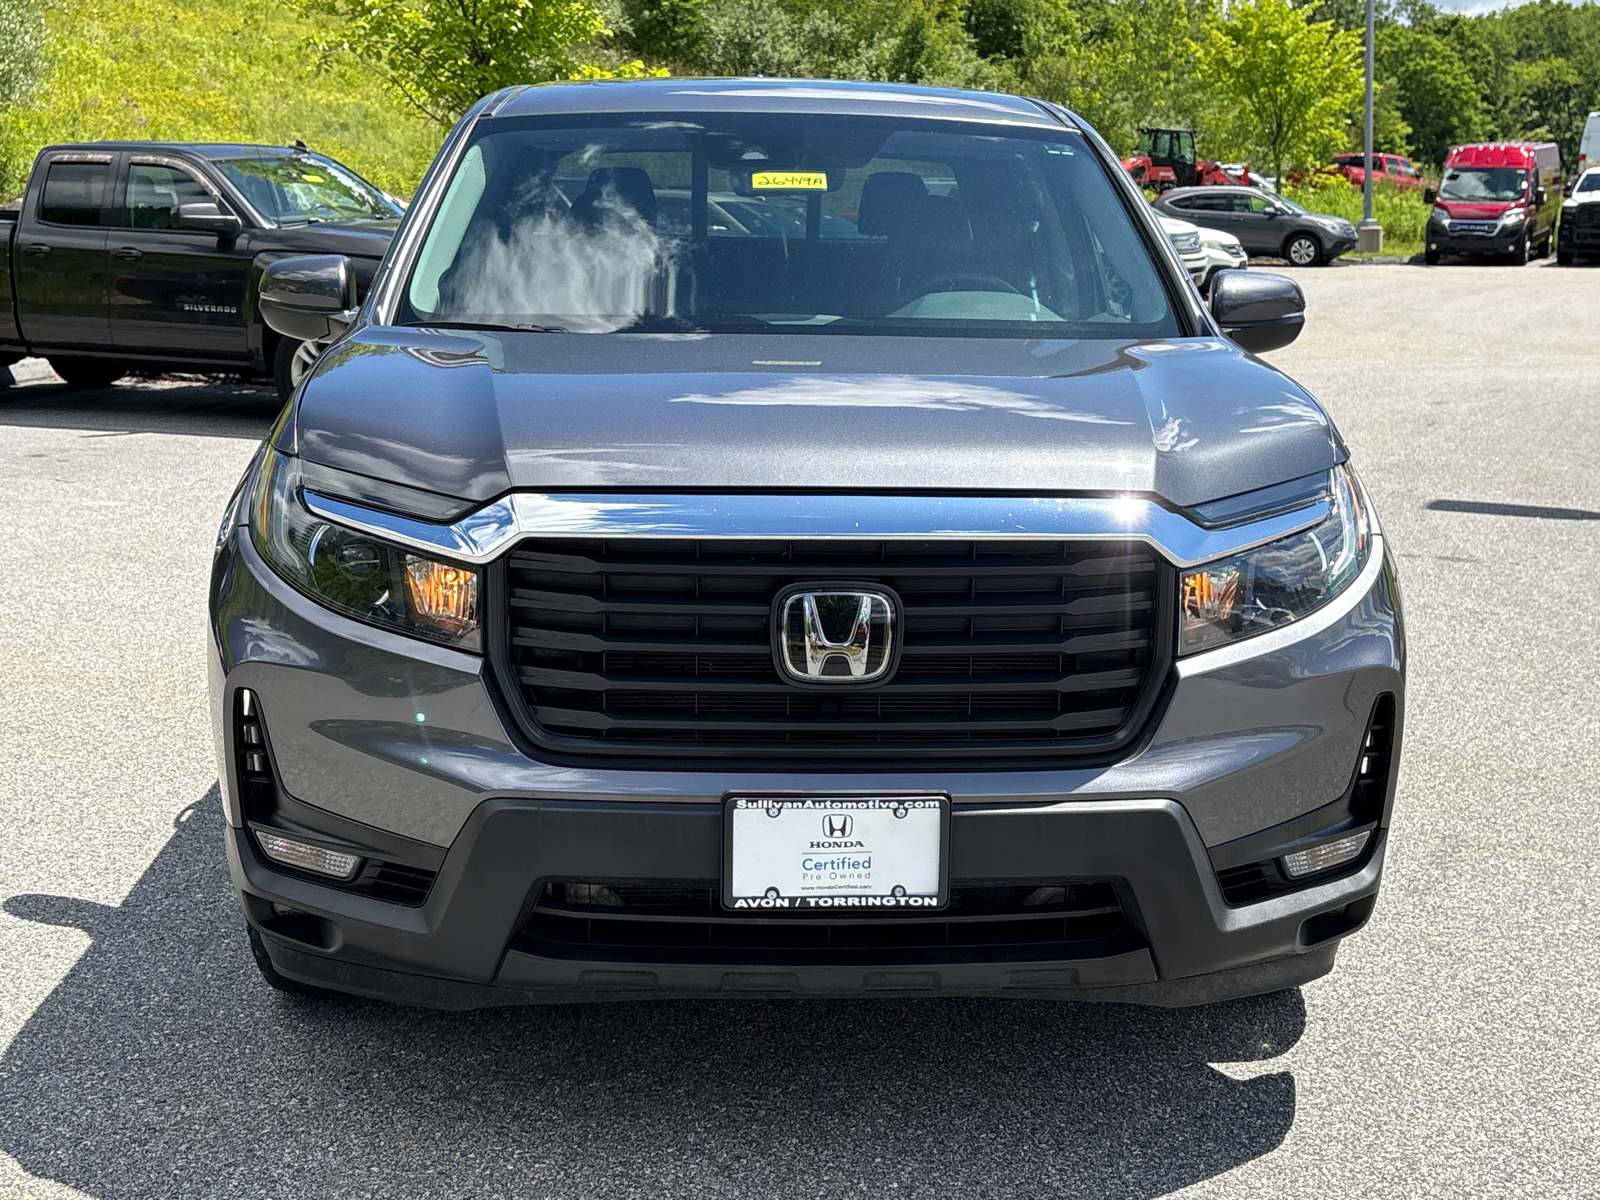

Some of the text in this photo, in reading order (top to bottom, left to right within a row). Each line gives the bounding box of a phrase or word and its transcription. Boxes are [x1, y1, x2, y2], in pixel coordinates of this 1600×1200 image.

[757, 175, 823, 186] 26449A
[183, 303, 237, 313] SILVERADO
[736, 798, 940, 809] SullivanAutomotive.com
[809, 840, 865, 849] HONDA
[801, 855, 872, 871] Certified
[802, 871, 871, 881] Pre-Owned
[733, 897, 790, 908] AVON
[806, 896, 938, 907] TORRINGTON
